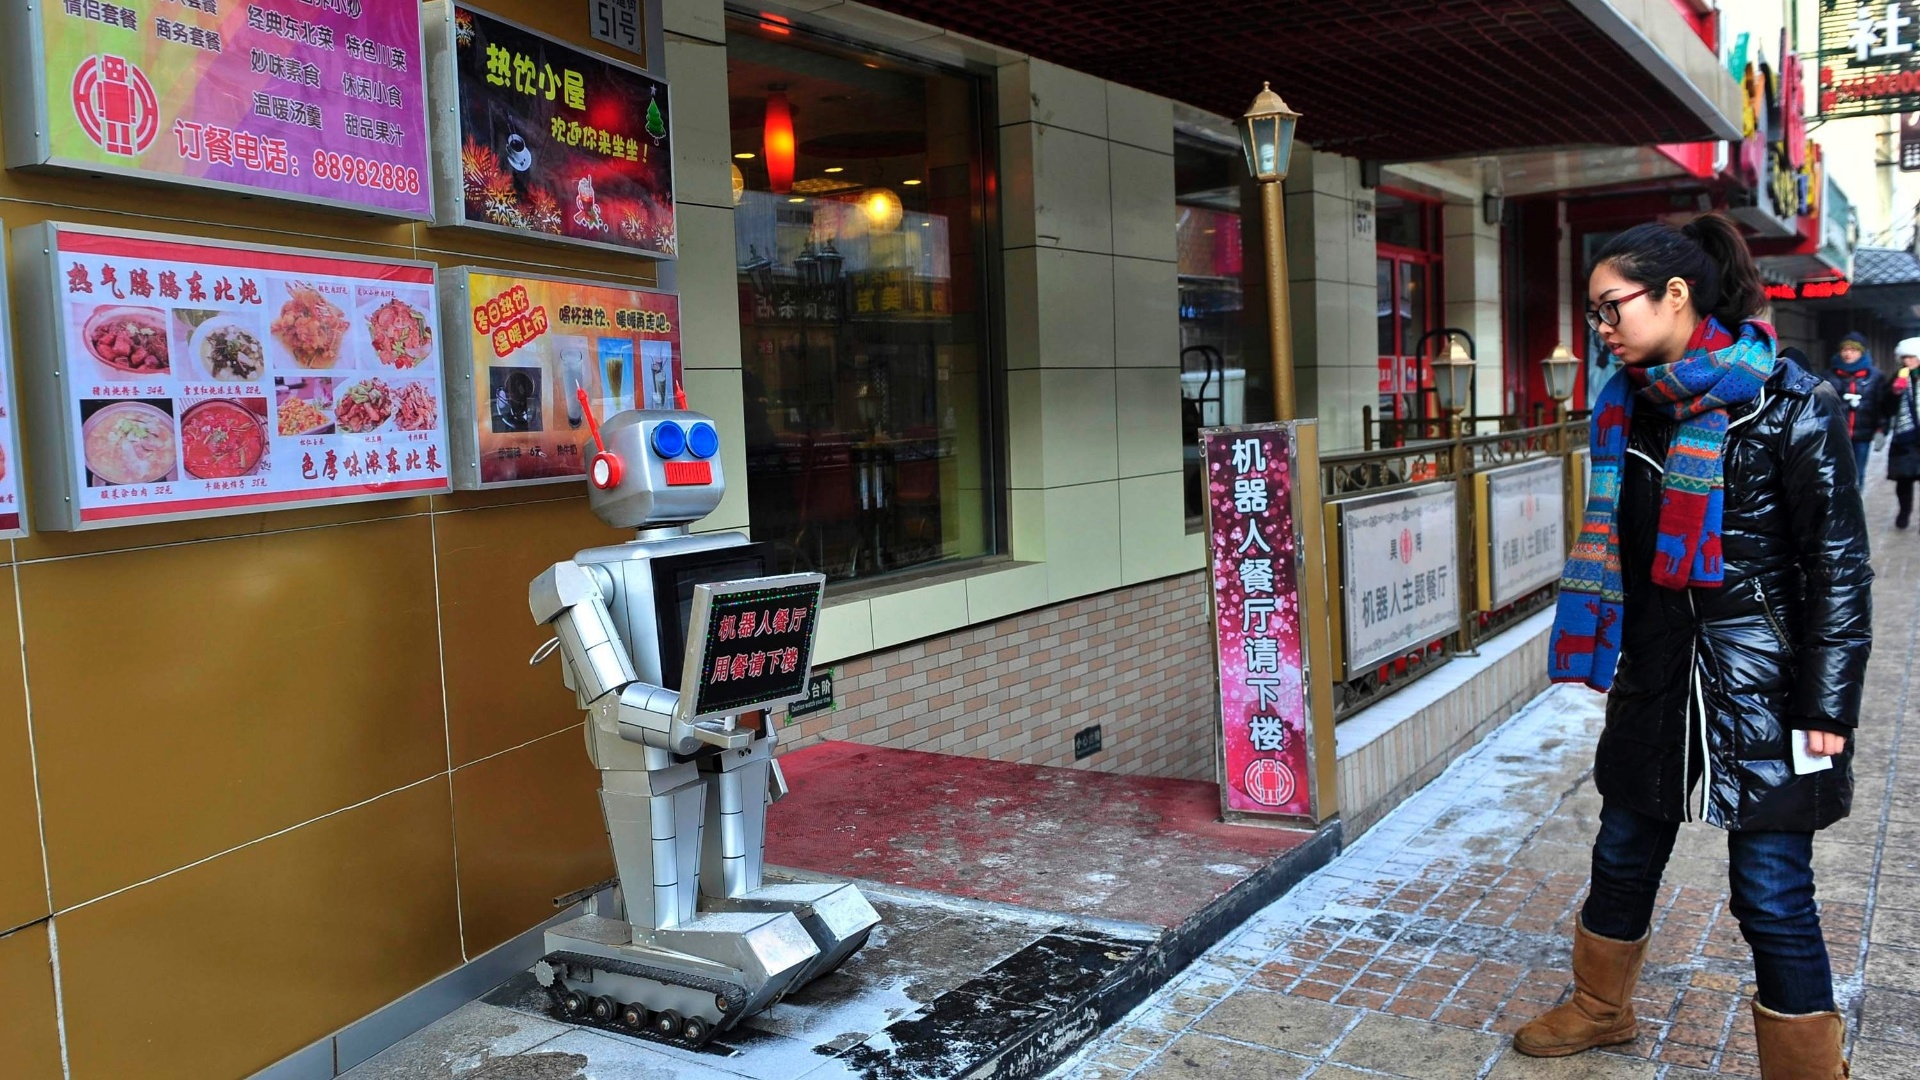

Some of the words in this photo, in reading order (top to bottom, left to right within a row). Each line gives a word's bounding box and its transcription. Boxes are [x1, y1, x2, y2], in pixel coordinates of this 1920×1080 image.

[63, 0, 138, 31] 情侣套餐
[170, 0, 218, 15] 套餐
[599, 2, 637, 45] 51号
[156, 18, 222, 53] 商务套餐
[247, 6, 335, 50] 经典东北菜
[1847, 2, 1913, 61] 社
[250, 48, 321, 88] 妙味素食
[345, 34, 408, 72] 特色川菜
[342, 72, 403, 108] 休闲小食
[486, 43, 586, 110] 热饮小屋
[253, 92, 323, 130] 温暖汤羹
[345, 114, 405, 146] 甜品果汁
[551, 117, 648, 163] 欢迎你来坐坐！
[66, 261, 263, 305] 热气腾腾东北炖
[475, 288, 528, 332] 冬日热饮
[494, 308, 546, 354] 温暖上市
[301, 444, 442, 481] 色厚味浓东北菜
[1232, 438, 1284, 752] 机器人餐厅请下楼
[1362, 565, 1448, 629] 机器人主题餐厅
[718, 608, 807, 641] 机器人餐厅
[711, 647, 798, 684] 用餐请下楼
